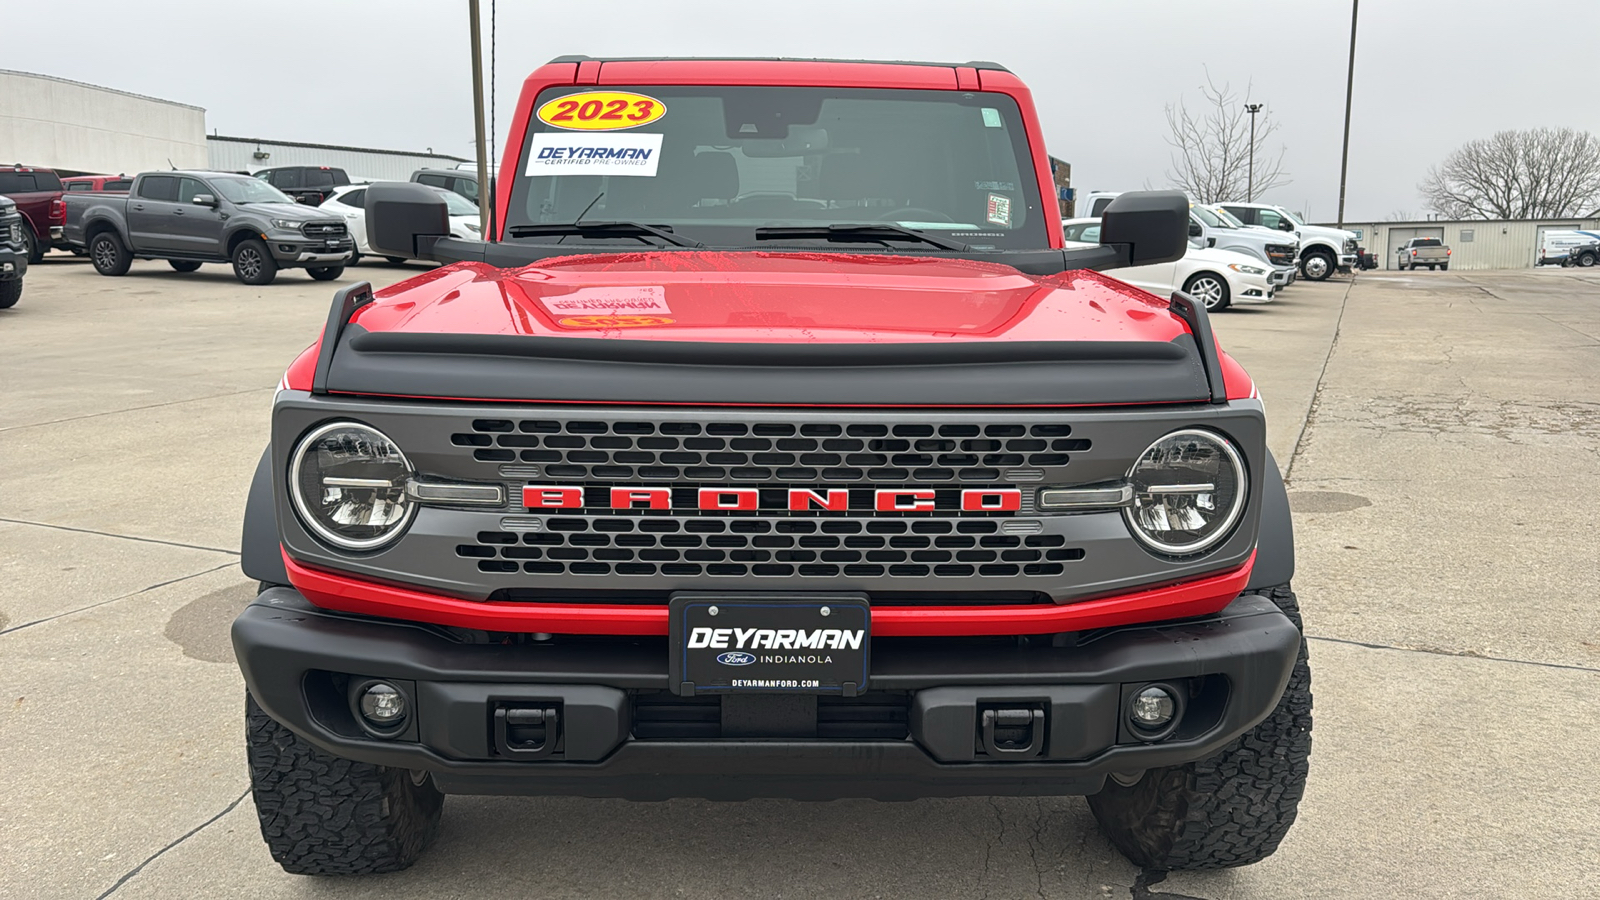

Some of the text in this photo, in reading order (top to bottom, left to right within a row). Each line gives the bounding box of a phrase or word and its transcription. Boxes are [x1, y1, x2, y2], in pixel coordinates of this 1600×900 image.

[550, 100, 654, 121] 2023
[537, 146, 653, 159] DEYARMAN
[522, 485, 1022, 512] BRONCO
[687, 627, 865, 650] DEYARMAN
[724, 653, 833, 664] Ford INDIANOLA
[732, 679, 819, 687] DEYARMANFORD.COM
